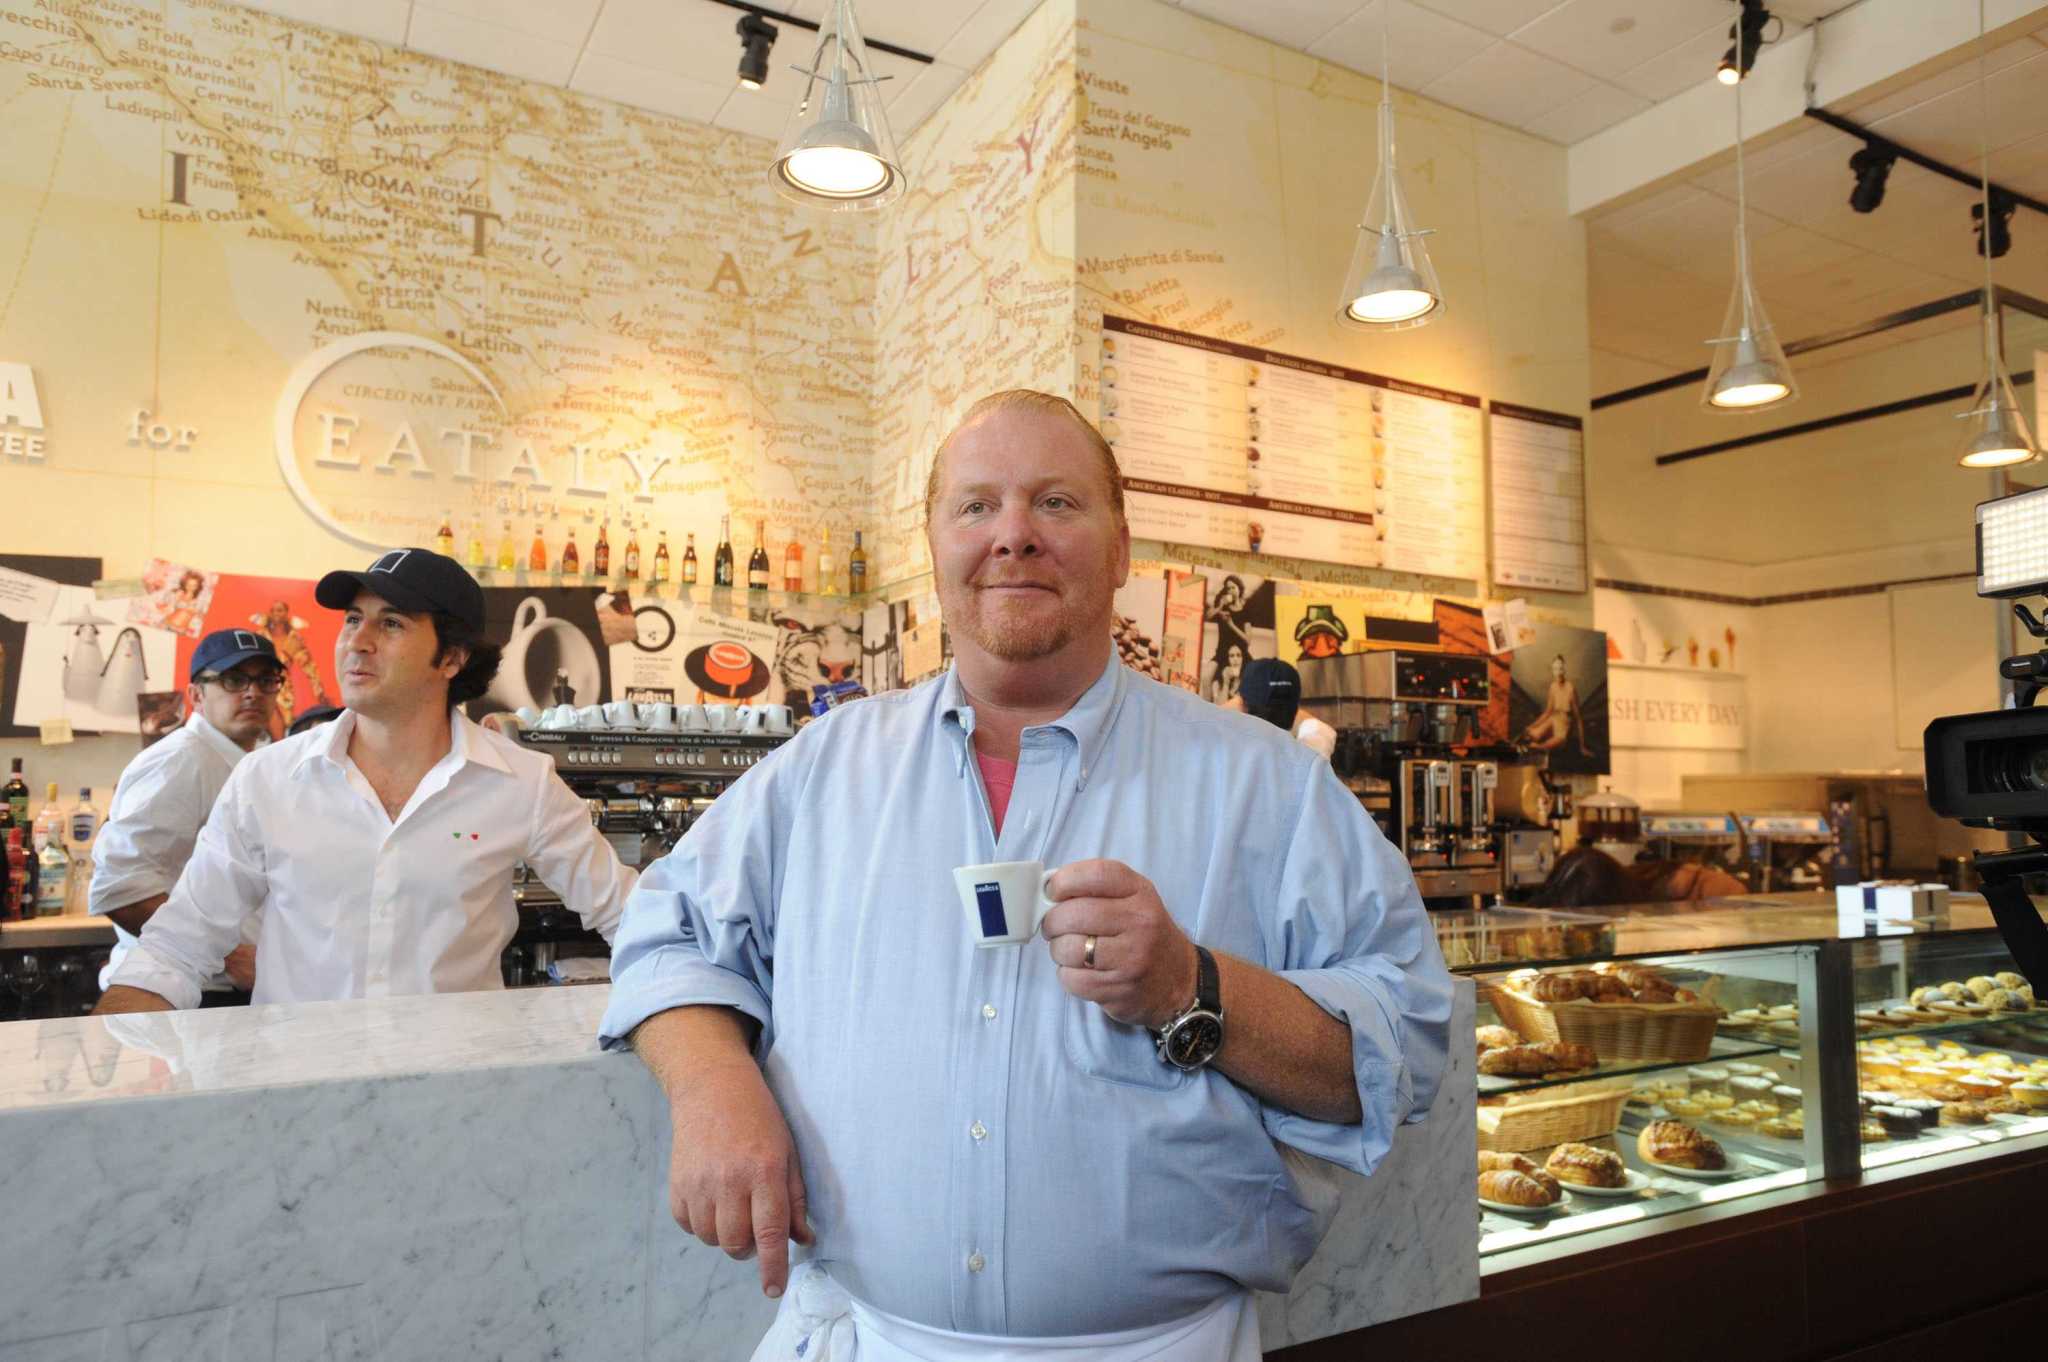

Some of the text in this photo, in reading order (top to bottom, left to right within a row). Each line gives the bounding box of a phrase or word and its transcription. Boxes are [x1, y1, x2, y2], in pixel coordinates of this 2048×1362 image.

[152, 27, 193, 48] Tolfa
[0, 41, 43, 63] Capo
[137, 37, 222, 68] Bracciano
[27, 72, 152, 91] Santa Severa
[118, 50, 256, 93] Santa Marinella
[104, 95, 182, 123] Ladispoli
[194, 86, 273, 112] Cerveteri
[176, 129, 310, 168] VATICAN CITY
[1121, 126, 1172, 150] Angelo
[195, 154, 264, 178] Fregene
[192, 170, 273, 199] Fiumicino
[343, 168, 416, 197] ROMA
[206, 209, 254, 222] Ostia
[312, 202, 380, 227] Marino
[1086, 250, 1167, 273] Margherita
[356, 280, 435, 299] Cisterna
[305, 298, 385, 323] Nettuno
[315, 318, 362, 335] Anzio
[460, 332, 522, 355] Latina
[343, 384, 406, 399] CIRCEO
[127, 408, 199, 447] for
[315, 411, 672, 503] EATALY
[624, 478, 720, 496] Mndragone
[1611, 699, 1746, 727] SH EVERY DAY
[591, 735, 623, 744] Espresso
